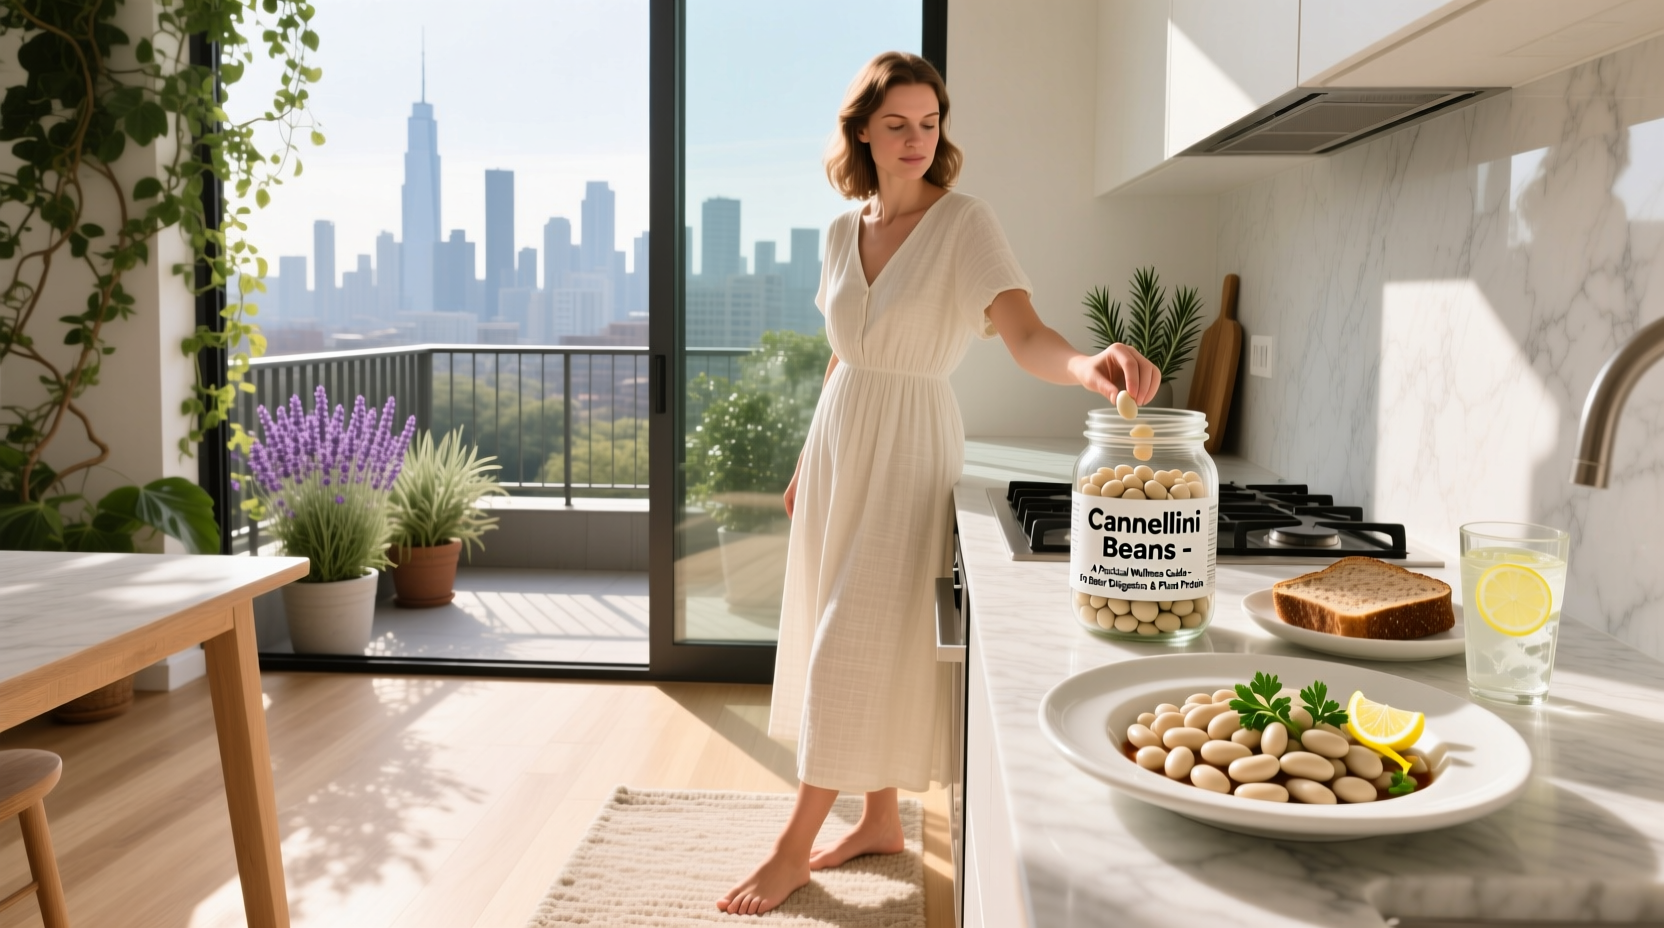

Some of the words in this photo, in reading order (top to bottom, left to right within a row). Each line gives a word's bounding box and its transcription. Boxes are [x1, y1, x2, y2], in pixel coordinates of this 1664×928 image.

[1088, 507, 1201, 534] Cannellini
[1103, 536, 1176, 560] Beans
[1090, 564, 1097, 573] A
